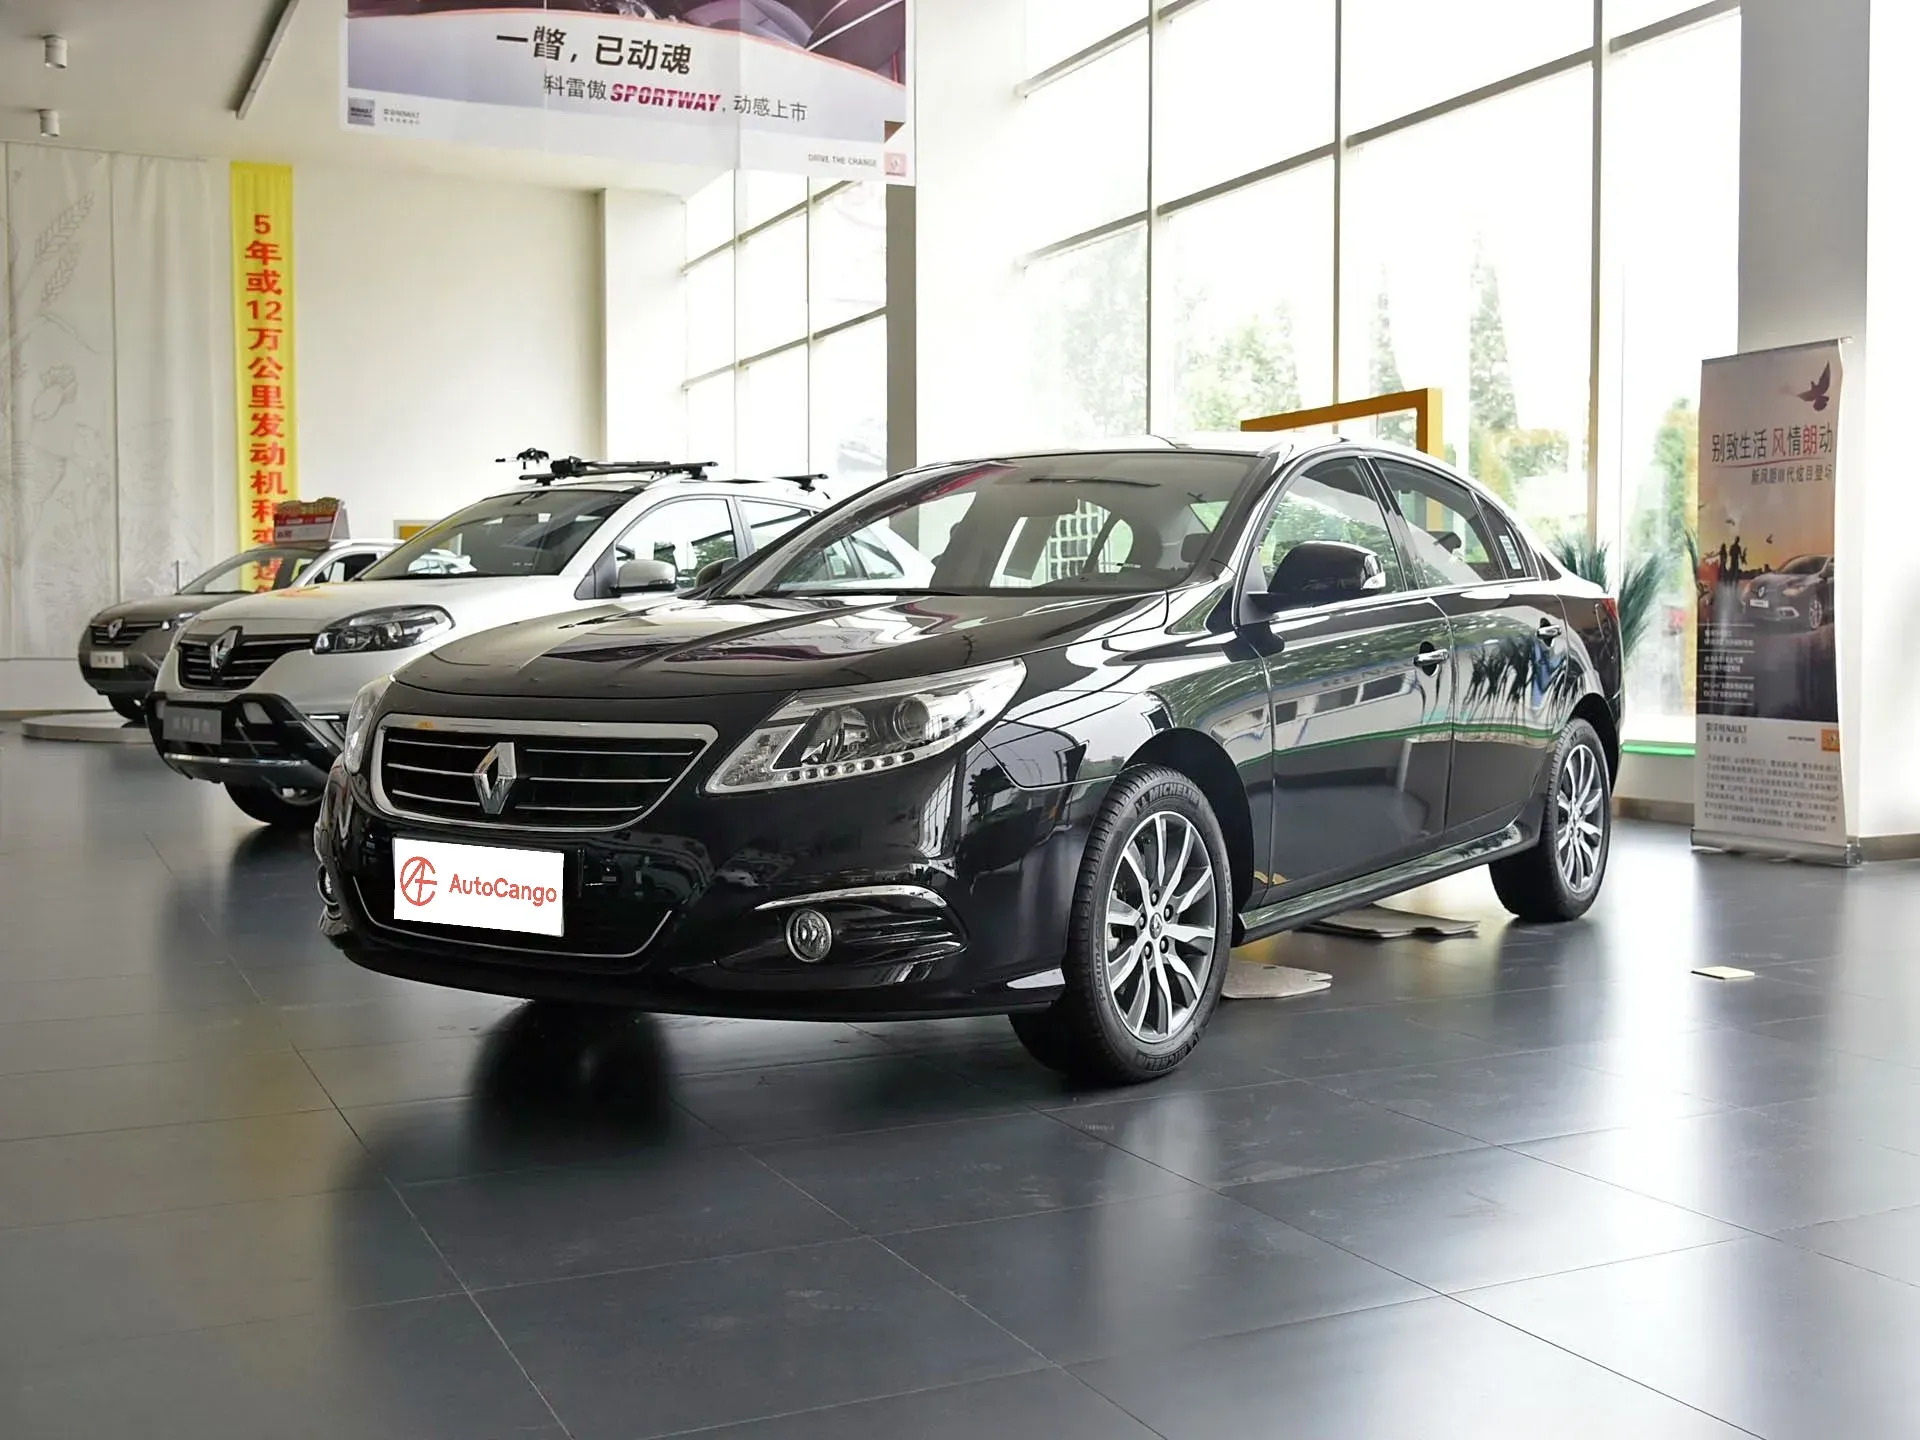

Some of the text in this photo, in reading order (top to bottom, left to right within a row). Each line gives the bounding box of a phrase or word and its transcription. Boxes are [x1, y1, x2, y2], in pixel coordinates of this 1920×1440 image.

[1711, 421, 1834, 463] 别致生活 风情朗动
[1149, 783, 1200, 806] MICHELIN
